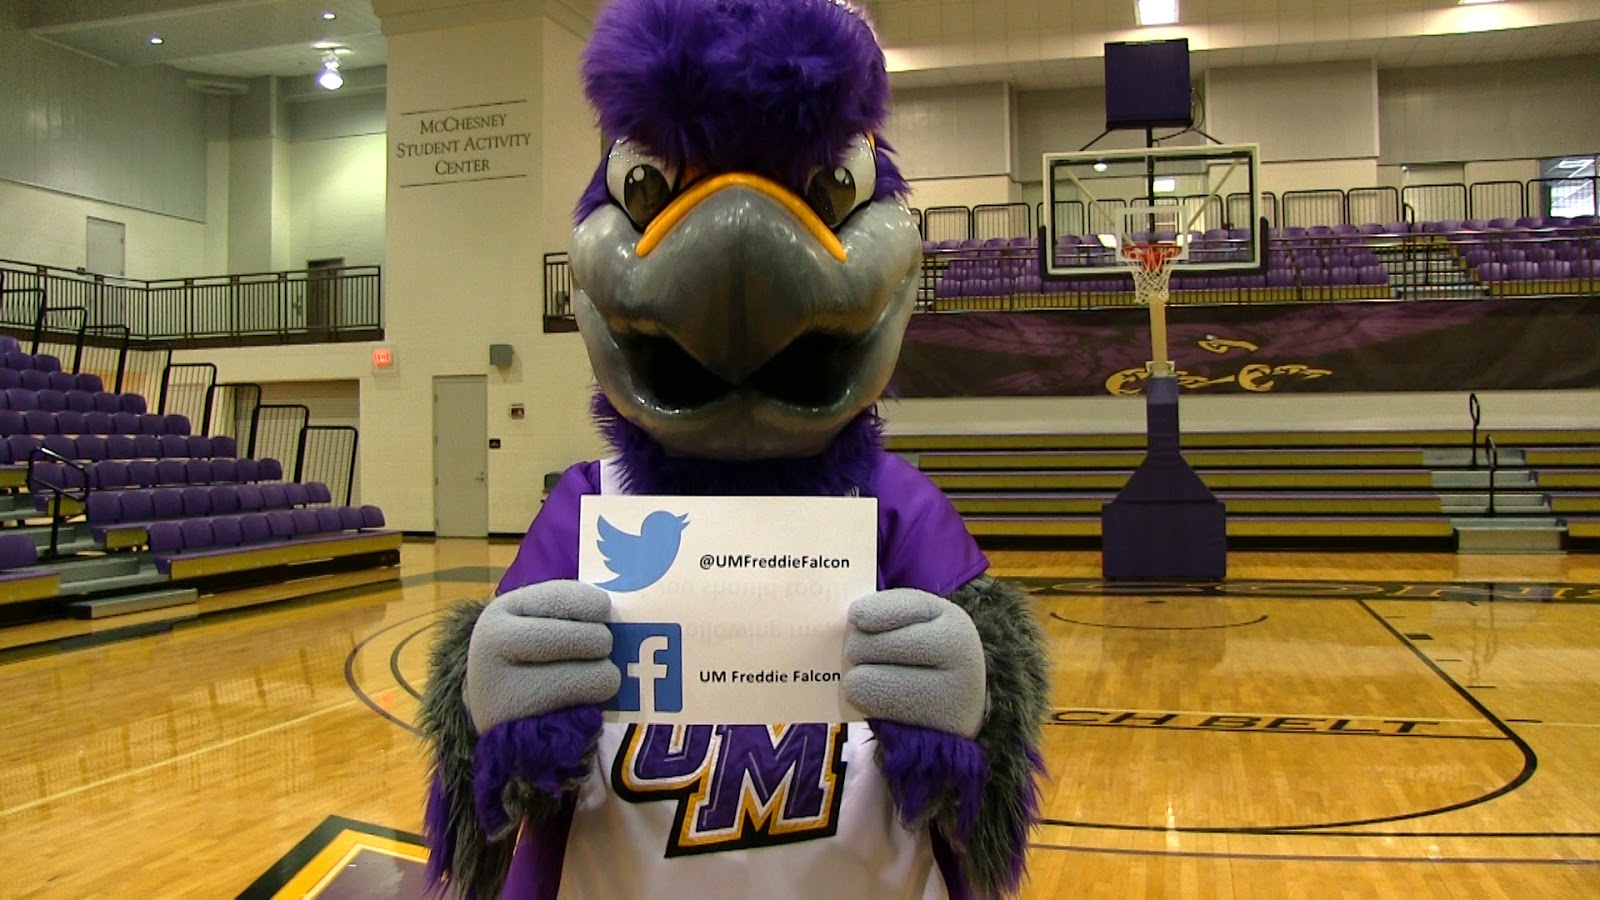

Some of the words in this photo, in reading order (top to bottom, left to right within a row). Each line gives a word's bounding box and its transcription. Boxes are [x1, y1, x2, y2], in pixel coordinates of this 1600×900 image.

[396, 141, 460, 158] STUDENT
[463, 133, 531, 152] ACTIVITY
[435, 159, 490, 175] CENTER
[699, 553, 850, 571] @UMFreddieFalcon
[699, 670, 727, 683] UM
[731, 669, 788, 683] Freddie
[792, 668, 842, 683] Falcon
[1196, 715, 1441, 734] BELT
[613, 722, 846, 855] UM
